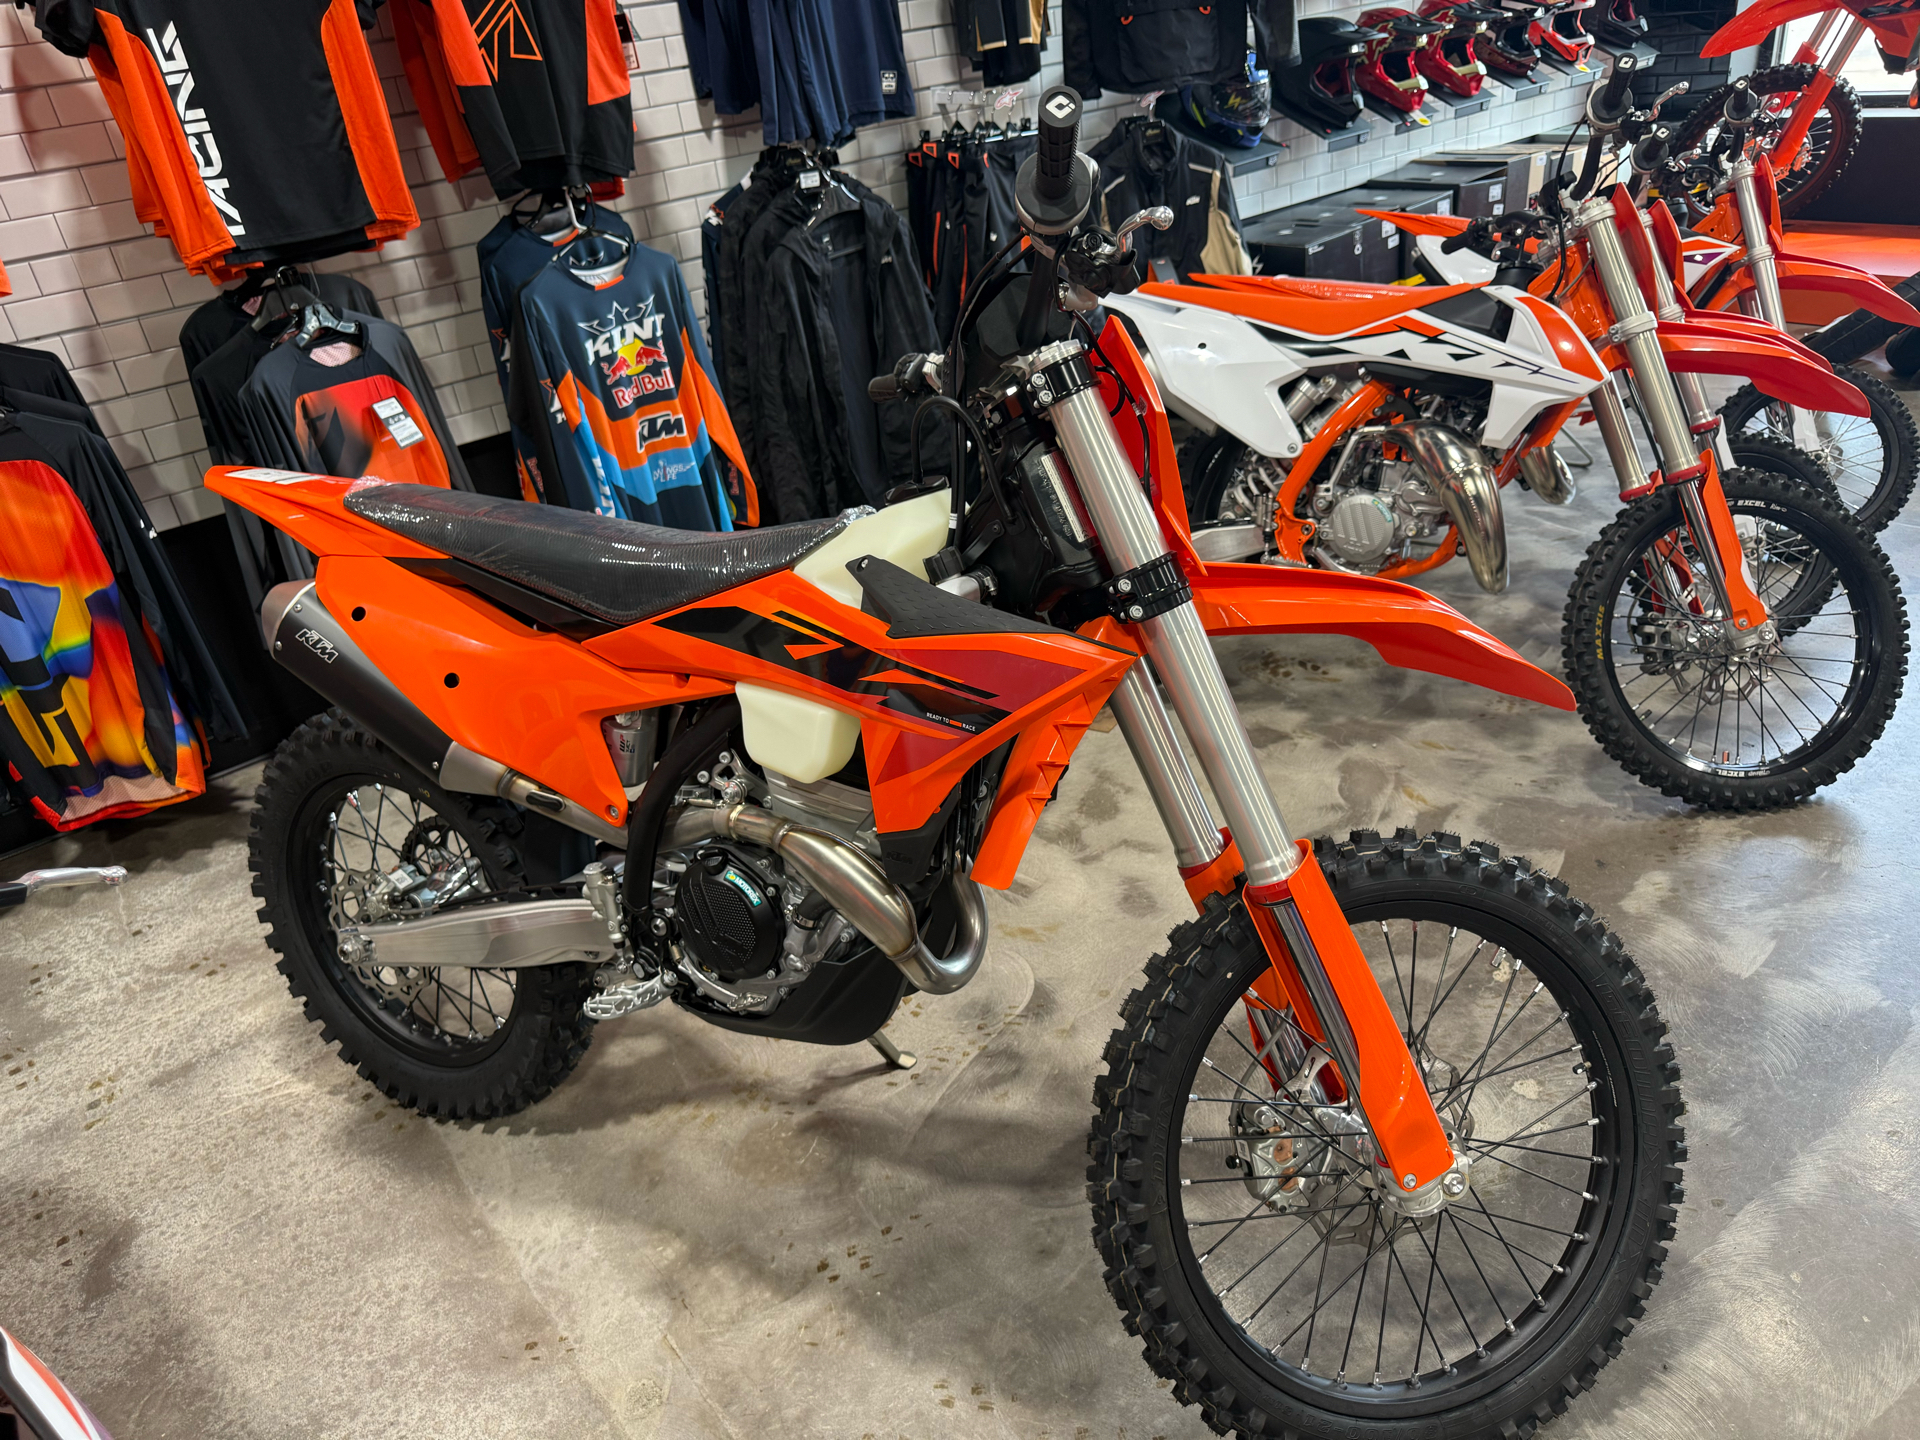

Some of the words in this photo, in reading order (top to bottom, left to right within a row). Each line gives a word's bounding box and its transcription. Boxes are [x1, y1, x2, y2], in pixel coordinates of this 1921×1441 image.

[584, 313, 666, 366] KINI
[612, 377, 642, 409] Red
[640, 366, 675, 394] Bull
[636, 410, 687, 453] KTM
[1737, 499, 1767, 509] EXCEL
[295, 628, 339, 664] KTM
[1594, 604, 1606, 661] MAXXIS
[926, 711, 943, 721] READY
[943, 716, 950, 724] TO
[962, 722, 976, 732] RACE
[1715, 768, 1745, 778] EXCEL
[734, 875, 761, 905] MOTOREX
[1595, 982, 1662, 1181] GEOMAX
